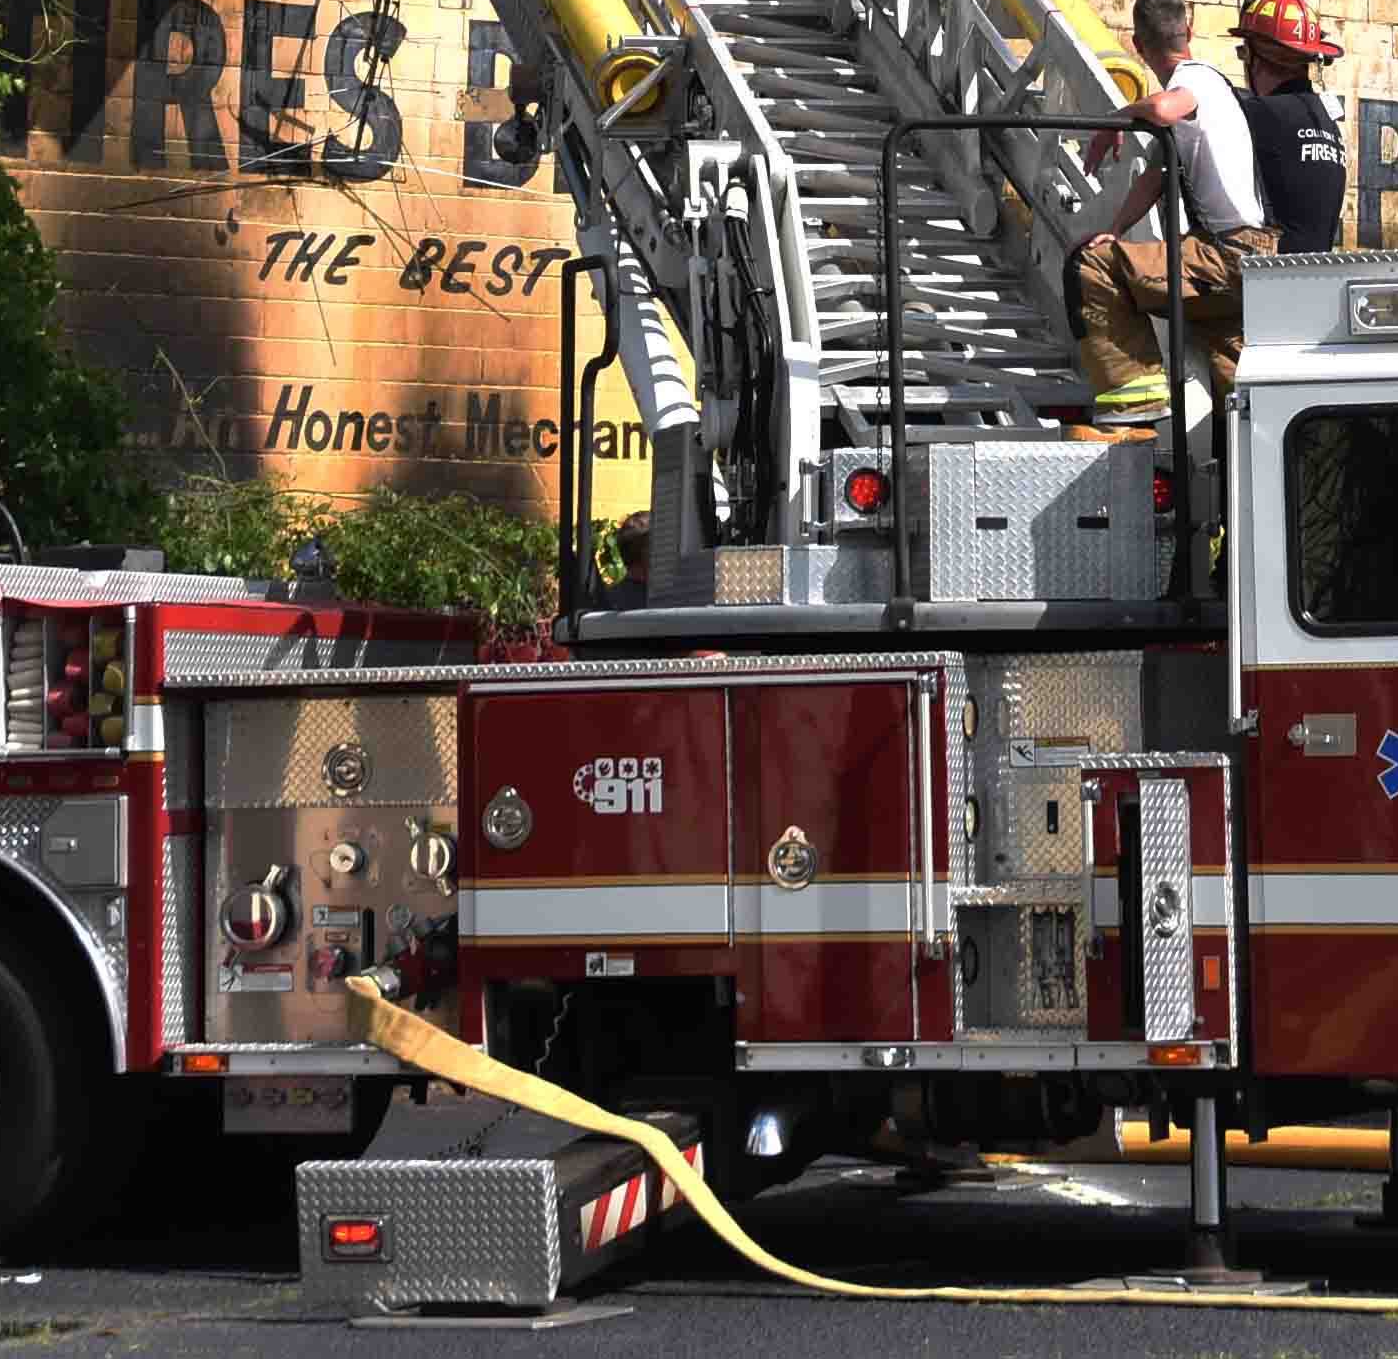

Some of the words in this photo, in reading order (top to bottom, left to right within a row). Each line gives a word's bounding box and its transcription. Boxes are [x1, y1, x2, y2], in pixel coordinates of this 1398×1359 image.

[258, 231, 376, 285] THE
[399, 237, 572, 297] BEST
[265, 384, 442, 452] Honest
[466, 391, 648, 460] Mecan
[594, 778, 663, 814] 911
